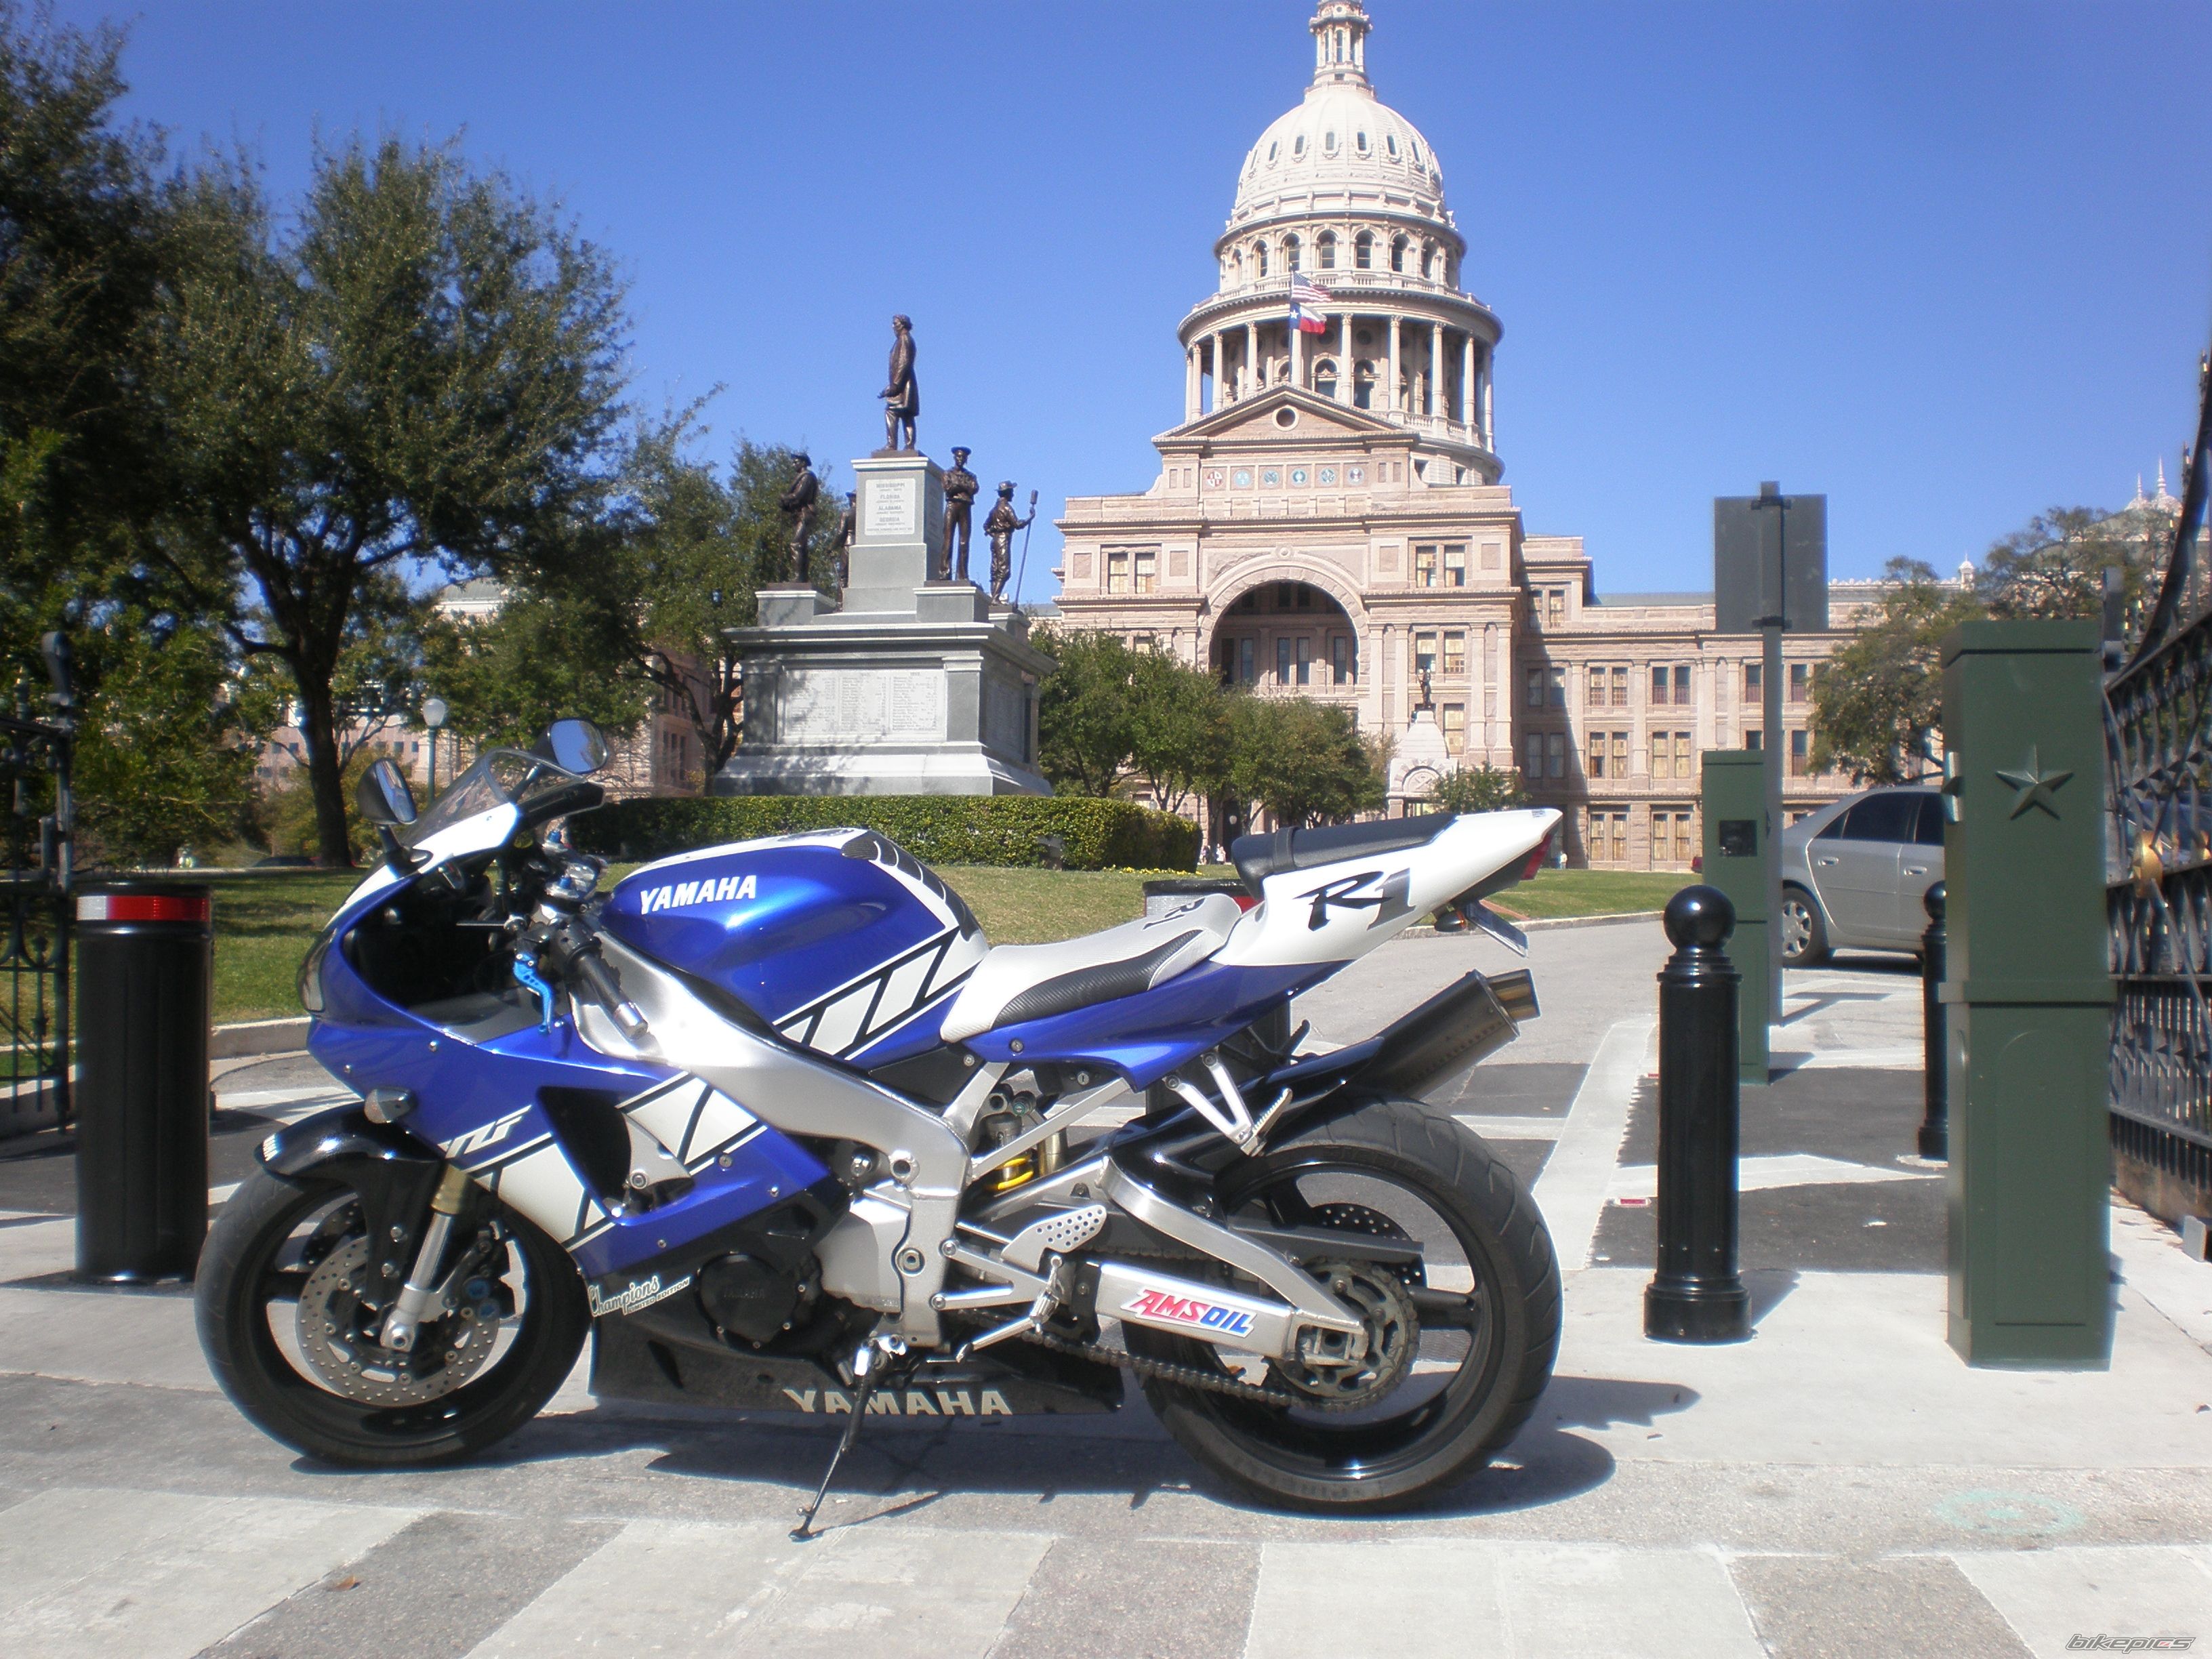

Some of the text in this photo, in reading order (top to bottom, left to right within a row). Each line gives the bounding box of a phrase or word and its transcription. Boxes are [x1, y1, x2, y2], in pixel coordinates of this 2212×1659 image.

[640, 875, 756, 915] YAMAHA
[1292, 867, 1416, 931] R1
[588, 1275, 660, 1317] Champions
[656, 1277, 691, 1302] EDITION
[1126, 1288, 1252, 1335] AMSOIL
[782, 1389, 1013, 1416] YAMAHA
